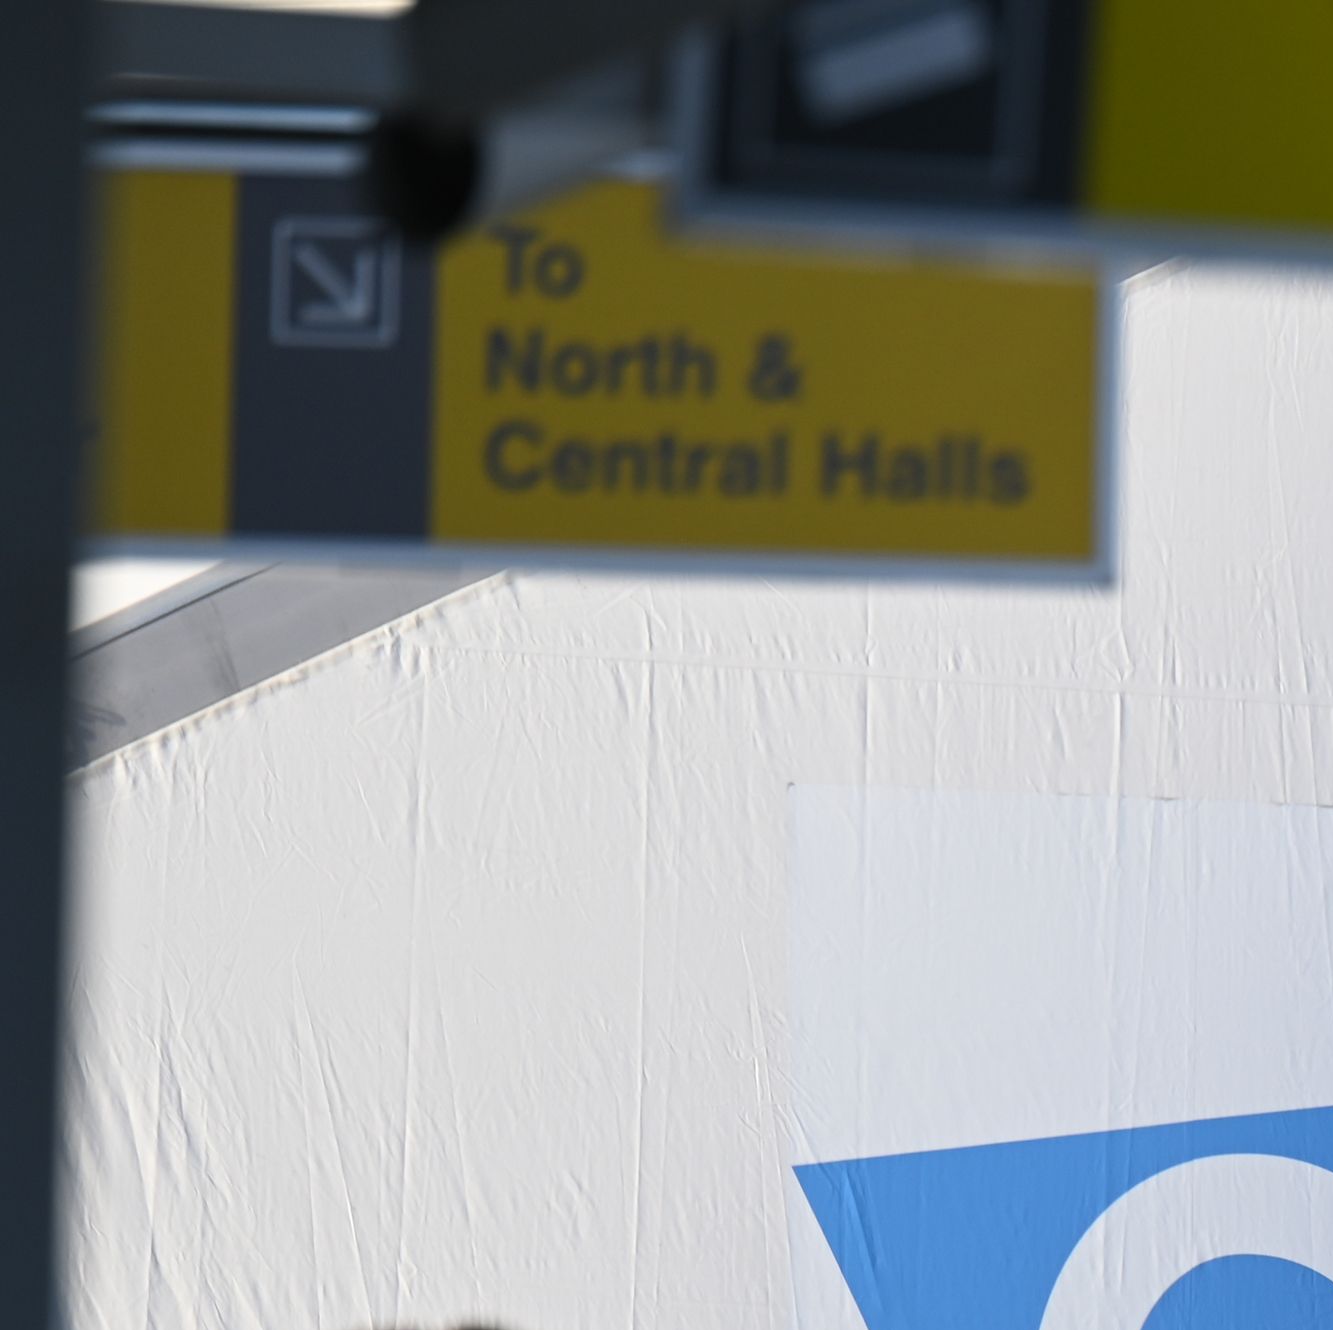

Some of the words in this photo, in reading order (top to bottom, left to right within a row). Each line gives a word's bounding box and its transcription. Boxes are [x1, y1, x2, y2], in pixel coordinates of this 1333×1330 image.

[490, 222, 585, 298] To
[482, 325, 717, 400] North
[748, 331, 804, 401] &
[482, 419, 791, 496] Central
[818, 433, 1031, 508] Halls
